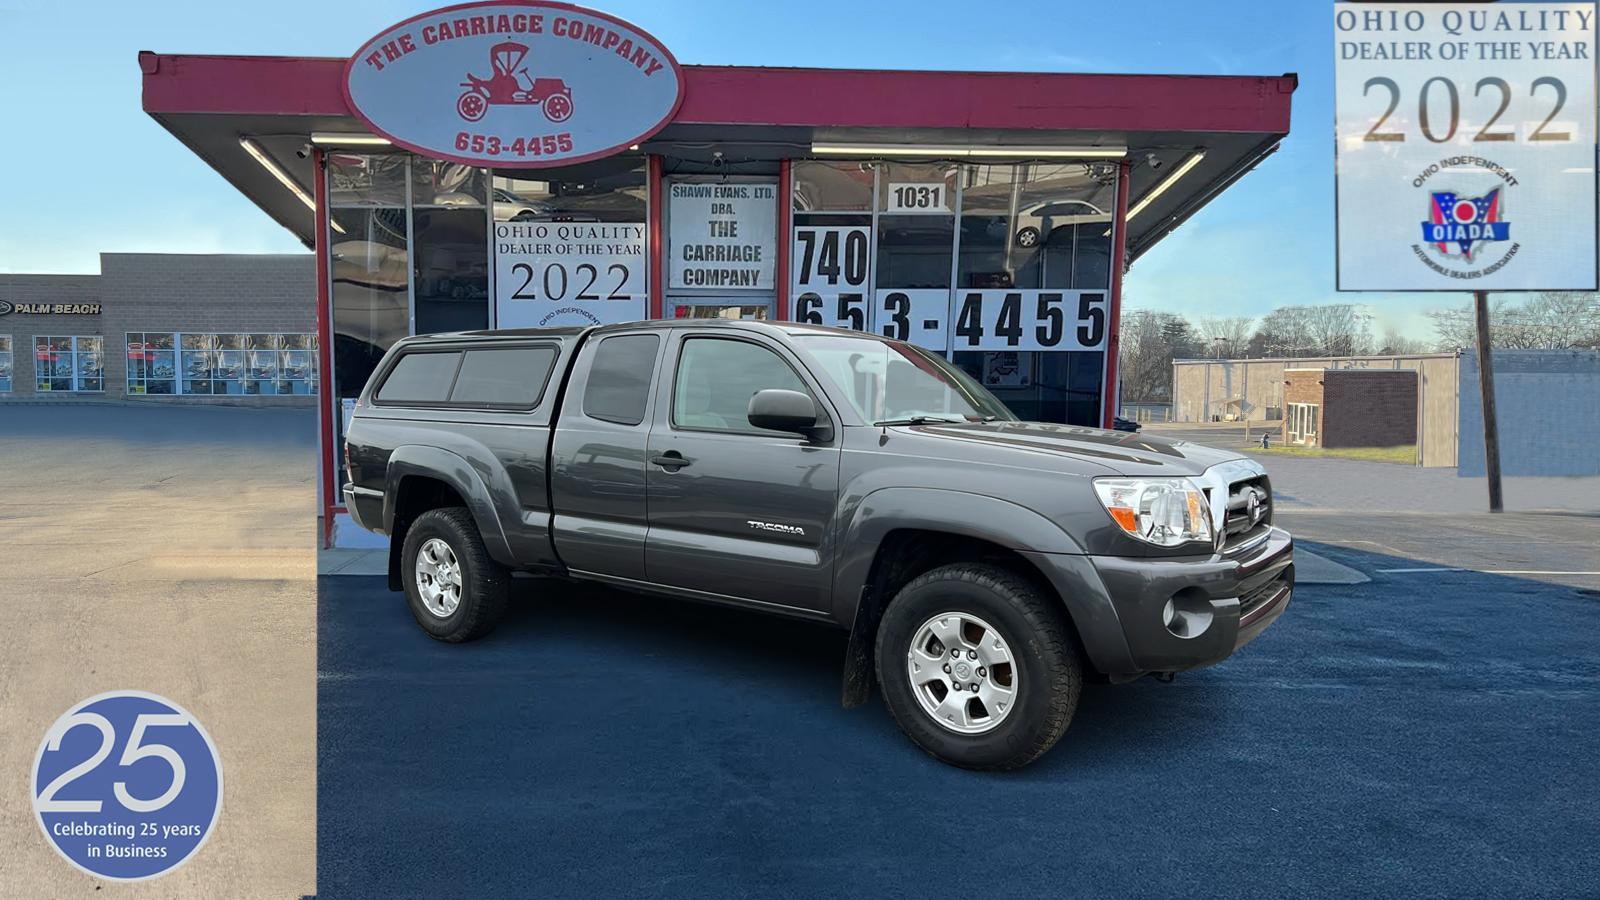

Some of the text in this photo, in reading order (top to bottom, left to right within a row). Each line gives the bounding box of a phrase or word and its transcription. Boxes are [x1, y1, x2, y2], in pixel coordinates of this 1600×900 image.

[1336, 10, 1592, 35] OHIO QUALITY
[366, 14, 664, 77] THE CARRIAGE COMPANY
[1340, 41, 1589, 60] DEALER OF THE YEAR
[1362, 76, 1571, 143] 2022
[455, 132, 573, 157] 653-4455
[1412, 155, 1519, 188] OHIO INDEPENDENT
[672, 185, 712, 198] SHAWN
[753, 185, 774, 199] LTD.
[894, 186, 940, 208] 1031
[711, 203, 735, 215] DBA.
[497, 226, 644, 241] OHIO QUALITY
[709, 221, 737, 238] THE
[1432, 224, 1496, 241] OIADA
[499, 244, 641, 255] DEALER OF THE YEAR
[683, 244, 761, 262] CARRIAGE
[797, 230, 868, 285] 740
[510, 263, 632, 301] 2022
[683, 268, 760, 286] COMPANY
[1450, 270, 1482, 280] DEALERS
[15, 304, 100, 313] PALM BEACH
[539, 312, 556, 327] OHIO
[796, 292, 1105, 347] 653-4455
[747, 520, 805, 535] TACOMA
